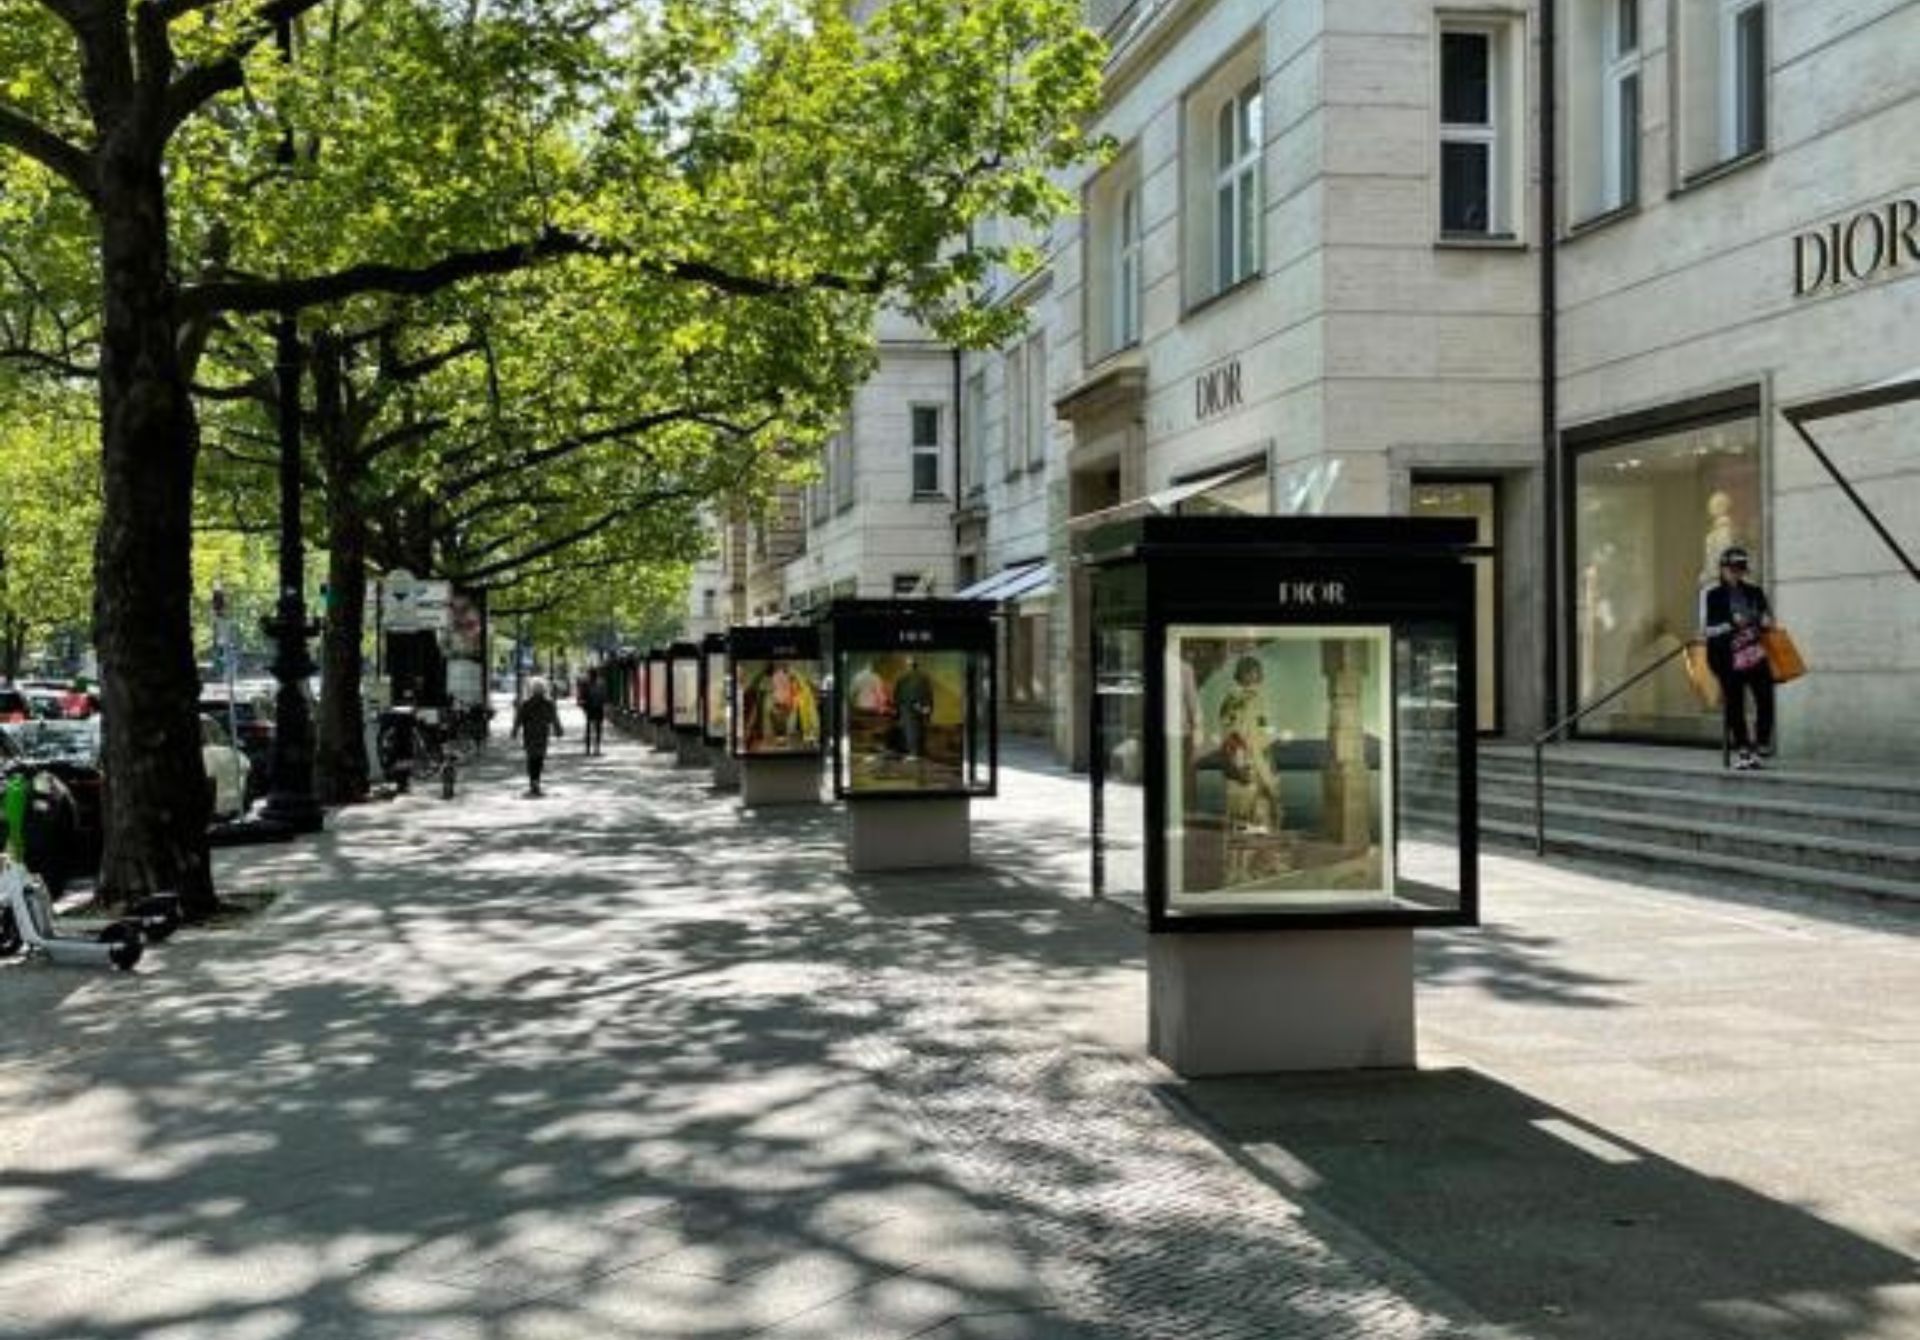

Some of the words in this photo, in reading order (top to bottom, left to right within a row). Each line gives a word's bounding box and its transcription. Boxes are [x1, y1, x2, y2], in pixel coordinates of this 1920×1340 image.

[1792, 199, 1920, 297] DIOR
[1195, 361, 1243, 420] DIOR
[1280, 581, 1344, 604] DIOR
